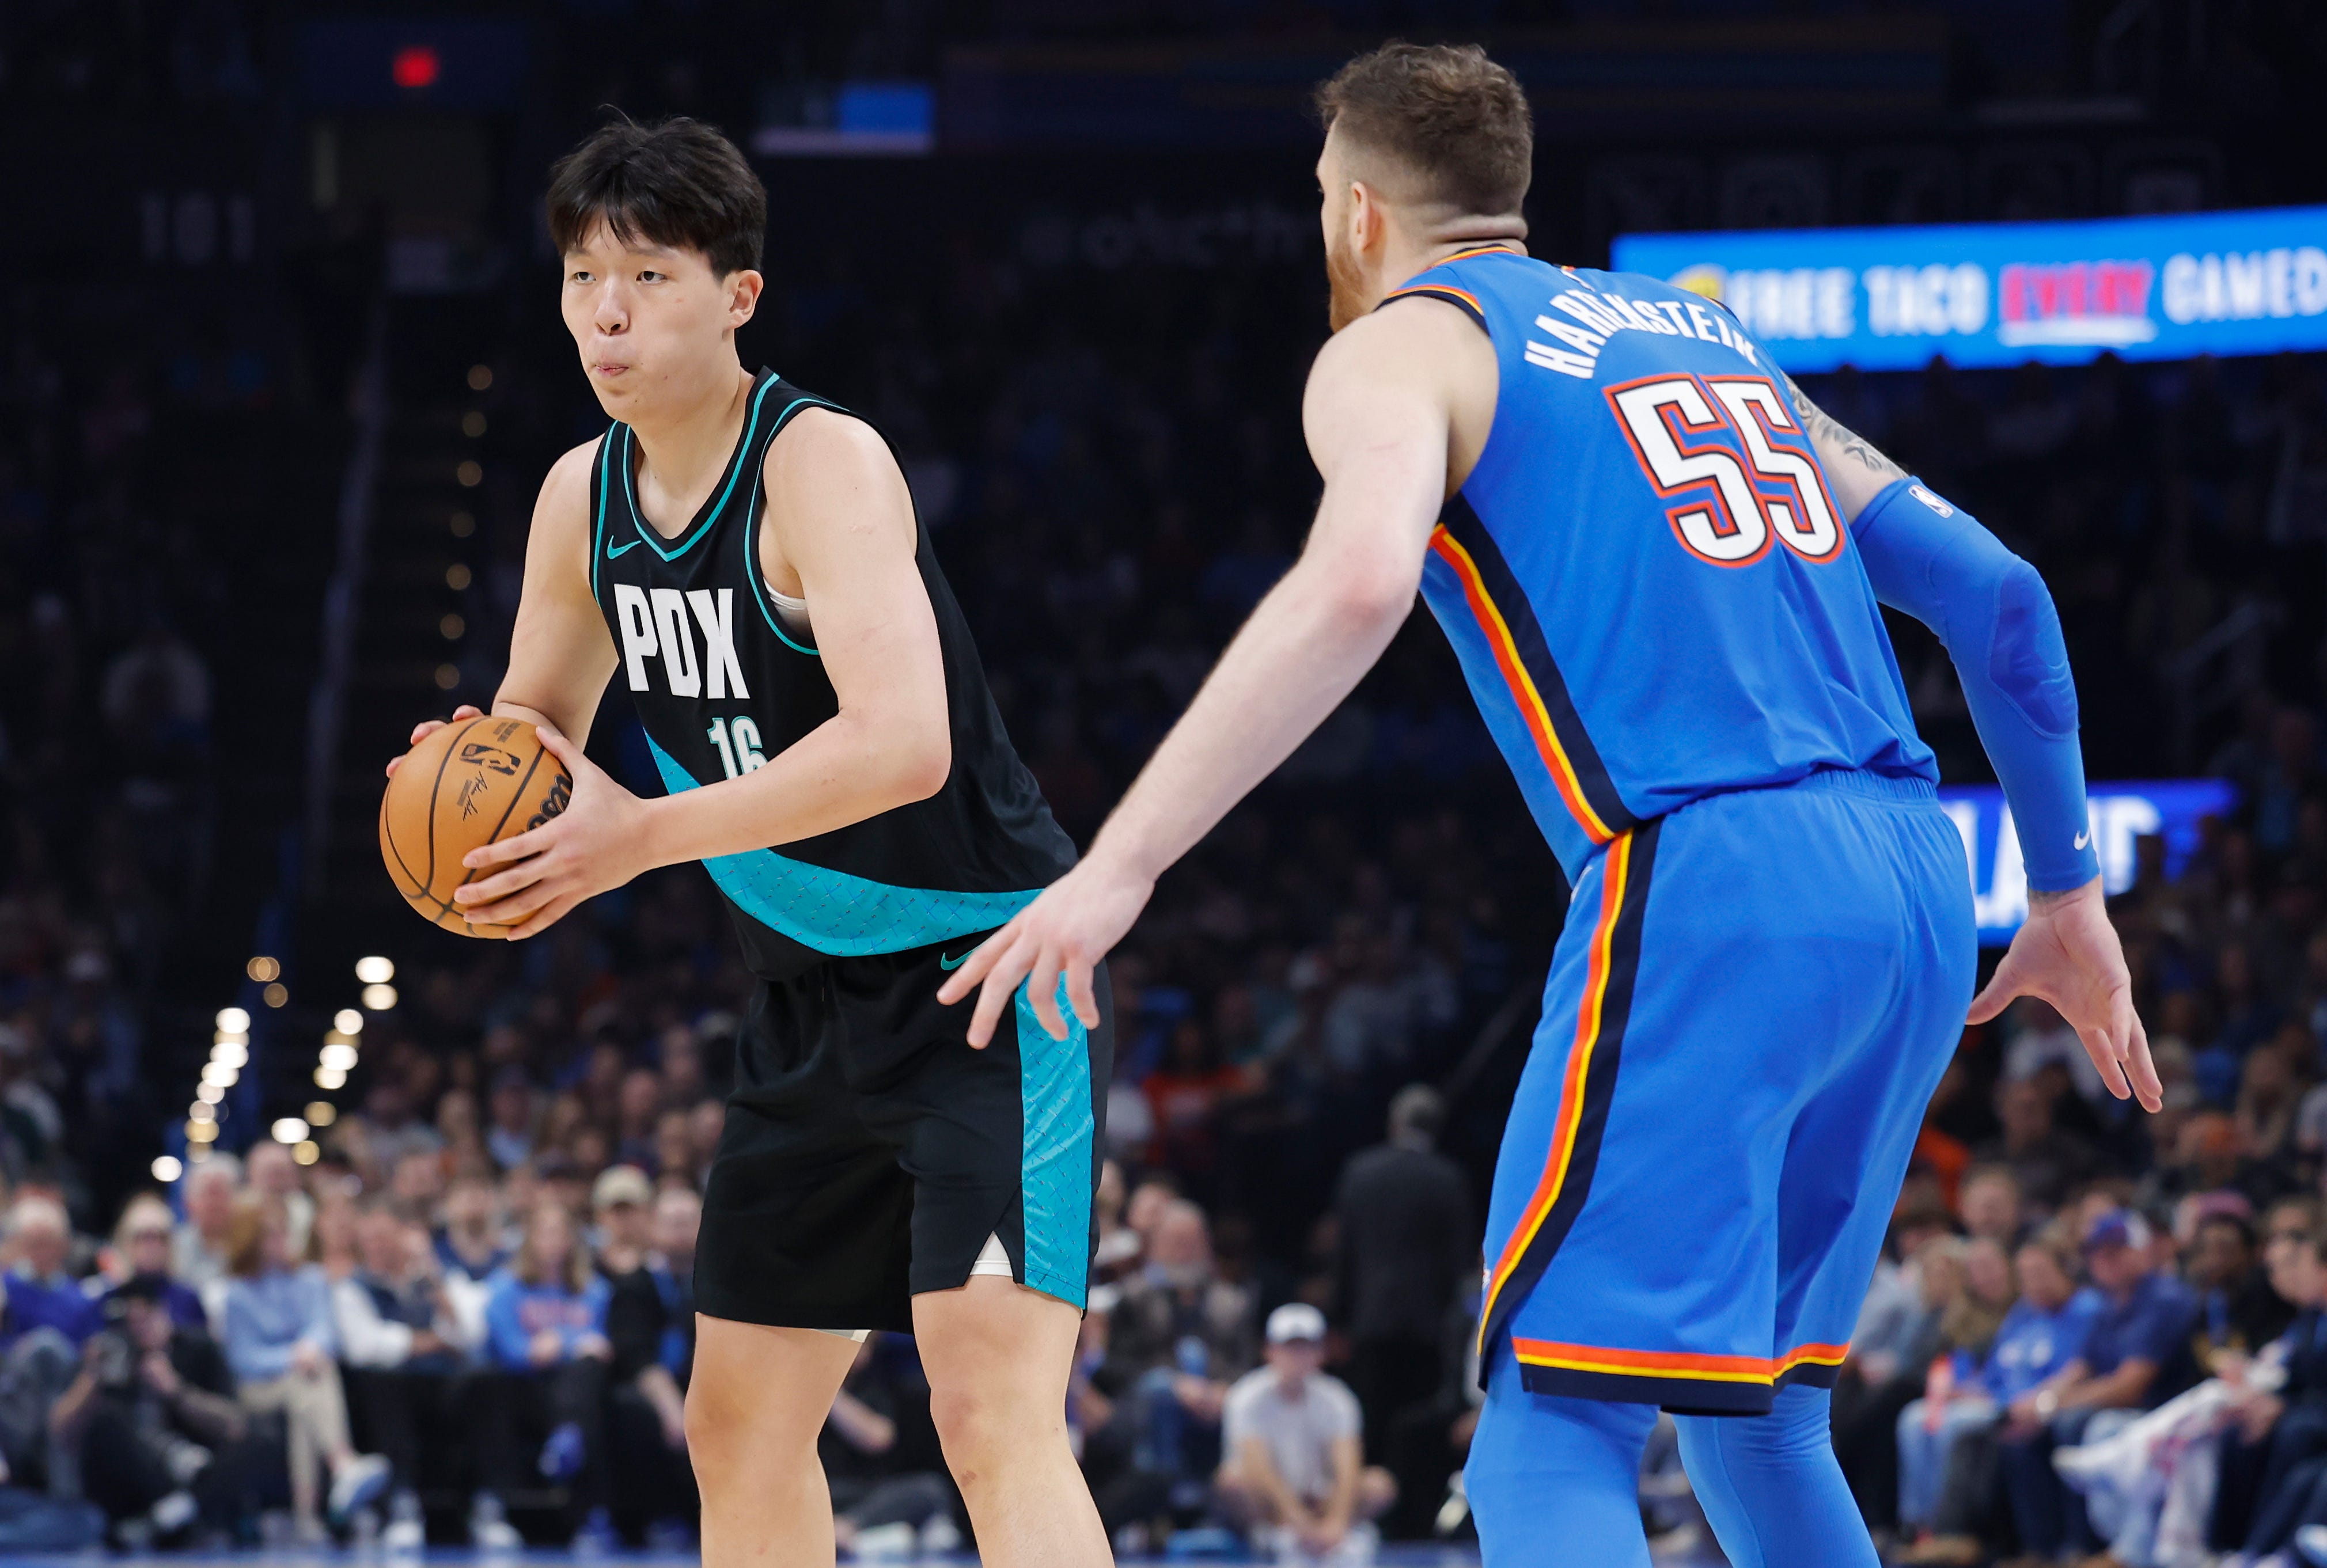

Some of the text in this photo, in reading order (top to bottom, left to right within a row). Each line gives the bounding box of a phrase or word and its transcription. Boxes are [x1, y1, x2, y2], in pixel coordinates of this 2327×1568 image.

[1601, 373, 1844, 569] 55
[613, 583, 751, 700] PDX
[707, 715, 770, 780] 16
